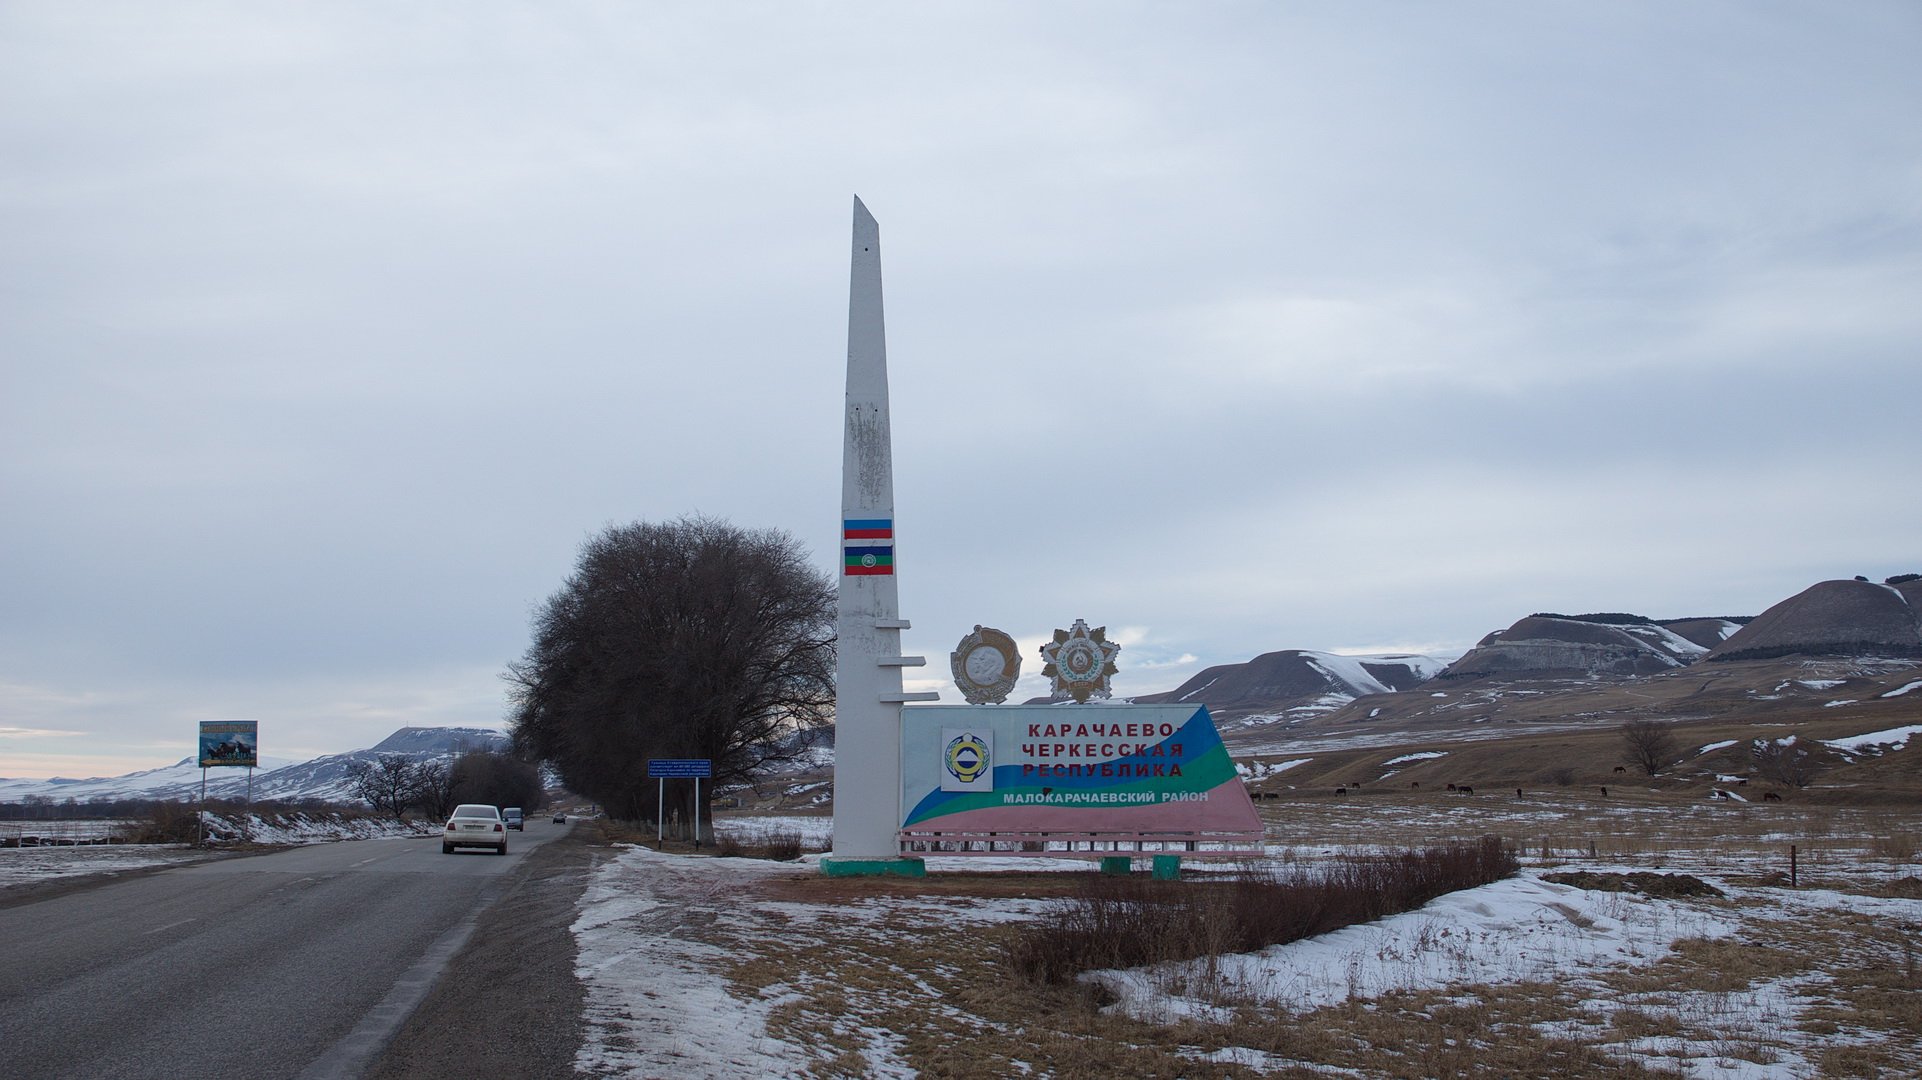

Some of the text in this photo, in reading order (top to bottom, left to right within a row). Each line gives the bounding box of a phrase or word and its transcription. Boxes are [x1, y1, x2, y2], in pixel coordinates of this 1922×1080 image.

[1028, 723, 1183, 738] КАРАЧАЕВО-
[1022, 743, 1183, 757] ЧЕРКЕССКАЯ
[1023, 763, 1183, 777] РЕСПУБЛИКА
[1003, 790, 1209, 804] МАЛОКАРАЧАЕВСКИЙ РАЙОН
